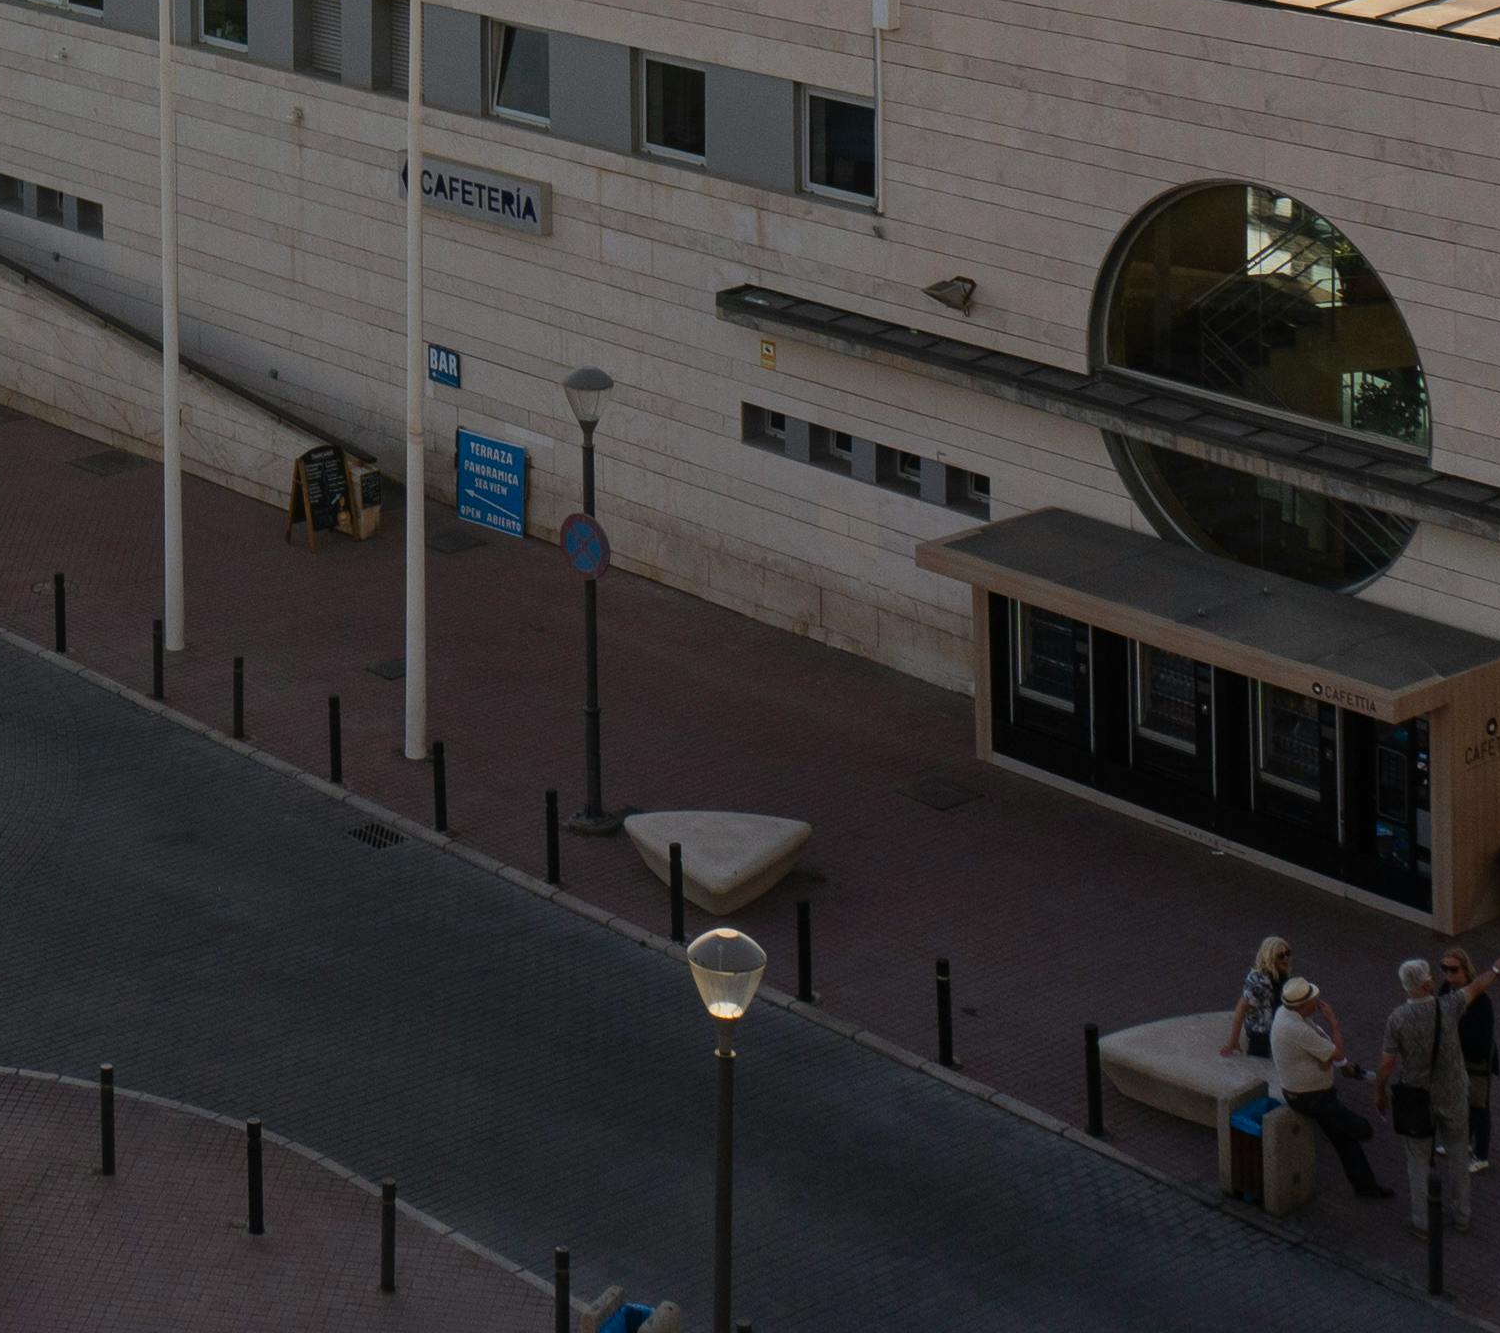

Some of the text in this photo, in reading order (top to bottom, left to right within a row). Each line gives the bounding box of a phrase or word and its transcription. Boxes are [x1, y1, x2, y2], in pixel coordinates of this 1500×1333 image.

[421, 169, 537, 223] CAFETERÍA
[429, 347, 458, 377] BAR
[469, 441, 513, 466] TERRAZA
[464, 459, 519, 487] PANORAMICA
[473, 477, 508, 497] SEA VIEW
[459, 504, 522, 533] OPEN ABIERTO
[1325, 685, 1377, 713] CAFETTIA
